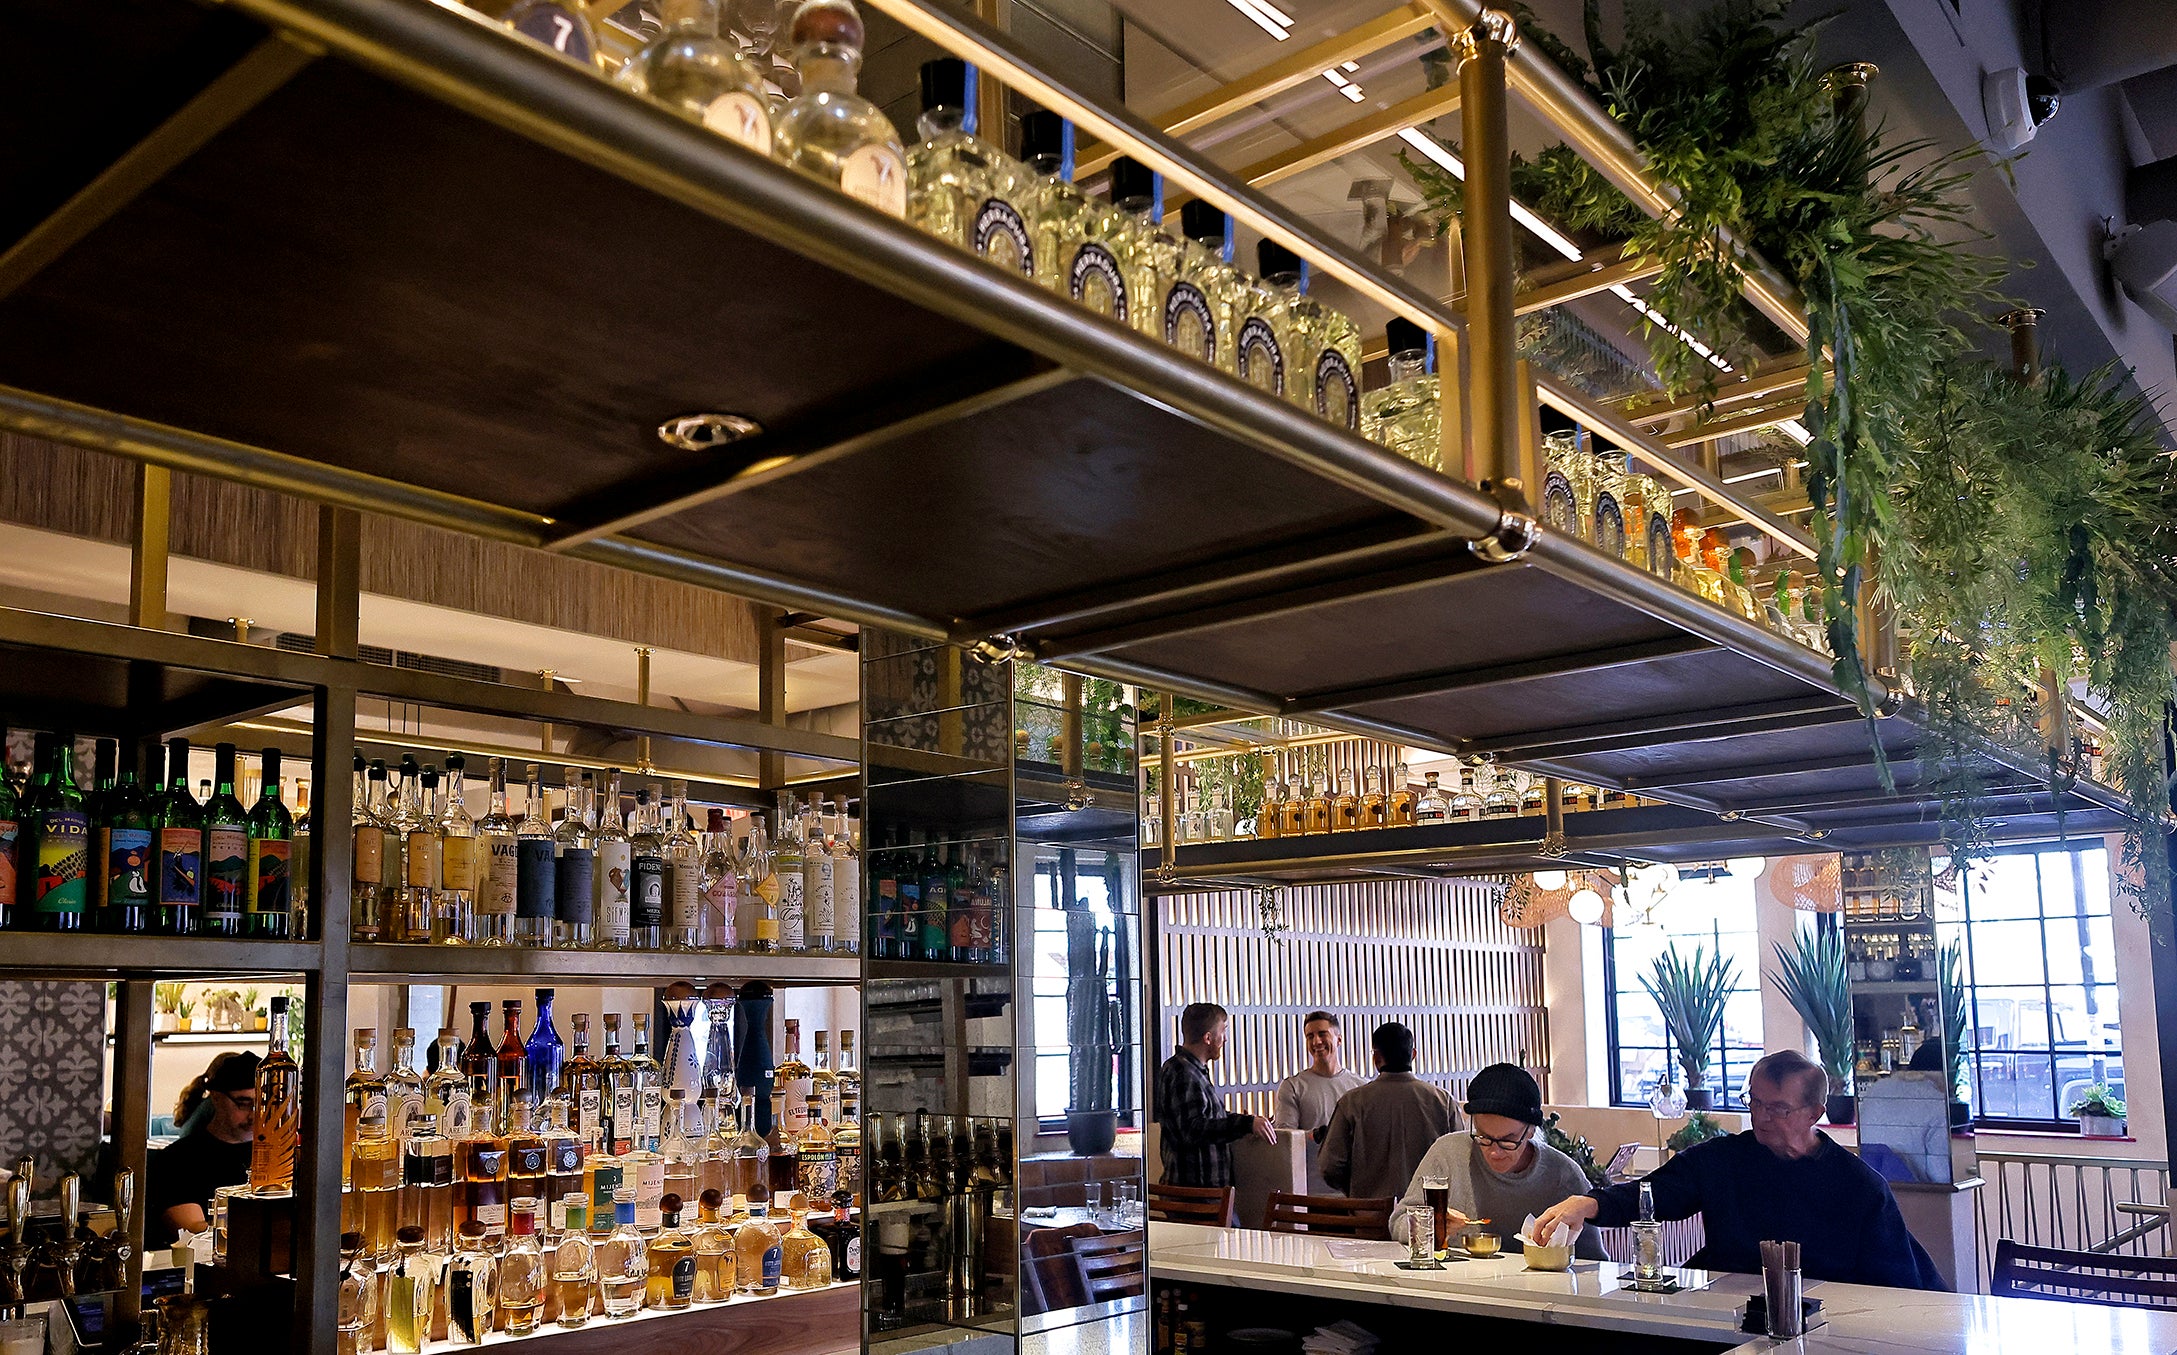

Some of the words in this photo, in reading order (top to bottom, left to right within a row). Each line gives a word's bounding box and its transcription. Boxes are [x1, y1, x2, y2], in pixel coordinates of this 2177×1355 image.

[553, 14, 573, 52] 7
[46, 824, 88, 835] VIDA
[684, 1260, 691, 1272] 7
